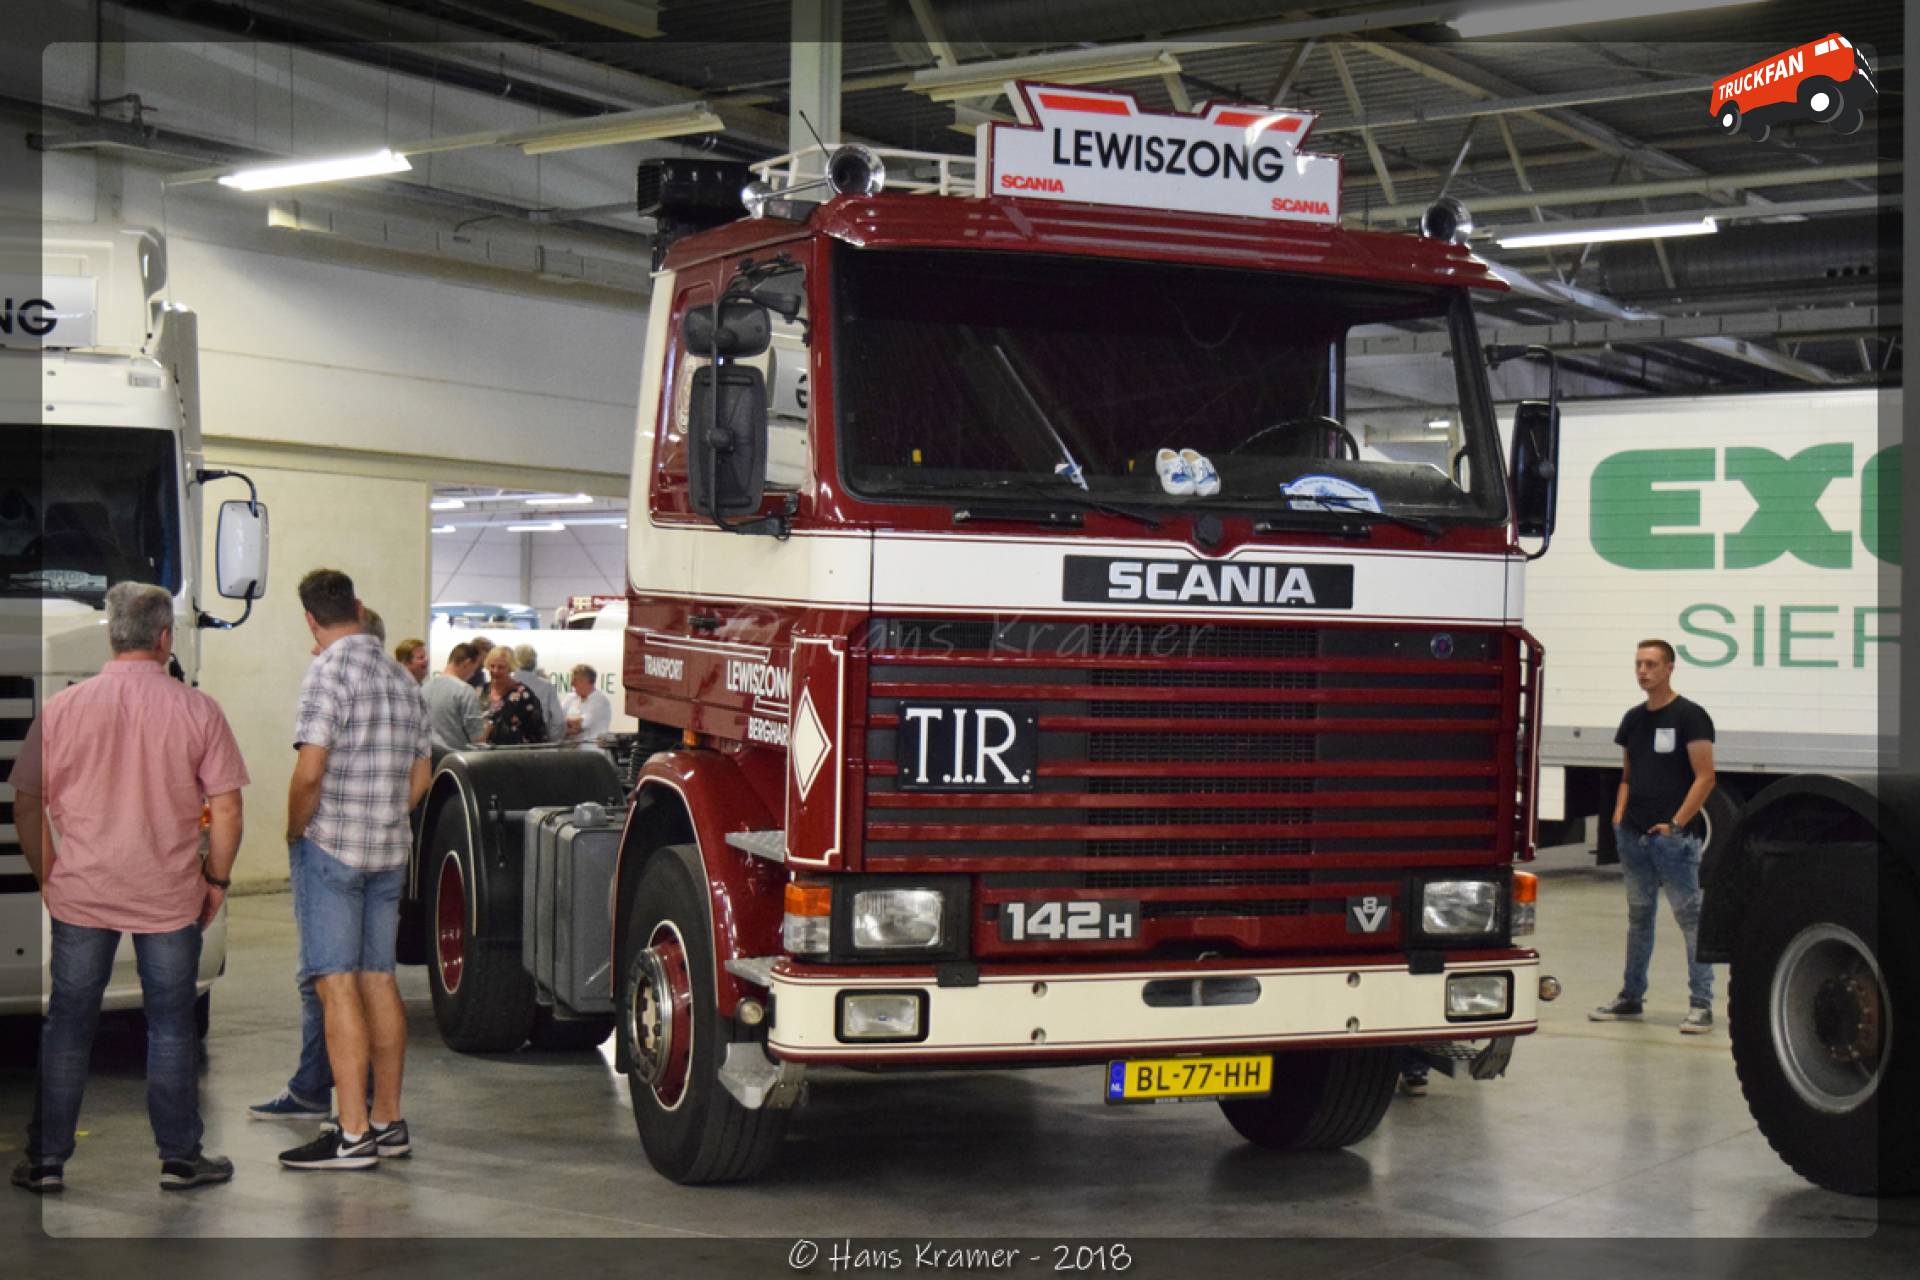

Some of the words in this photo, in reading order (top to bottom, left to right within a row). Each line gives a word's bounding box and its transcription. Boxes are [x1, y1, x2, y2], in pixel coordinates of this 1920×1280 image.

[1052, 126, 1285, 184] LEWISZONG
[1000, 173, 1065, 194] SCANIA
[1270, 197, 1331, 216] SCANIA
[1107, 560, 1317, 605] SCANIA
[643, 653, 685, 681] TRANSPORT
[726, 658, 791, 700] LEWISZON
[1136, 1060, 1261, 1092] BL-77-HH
